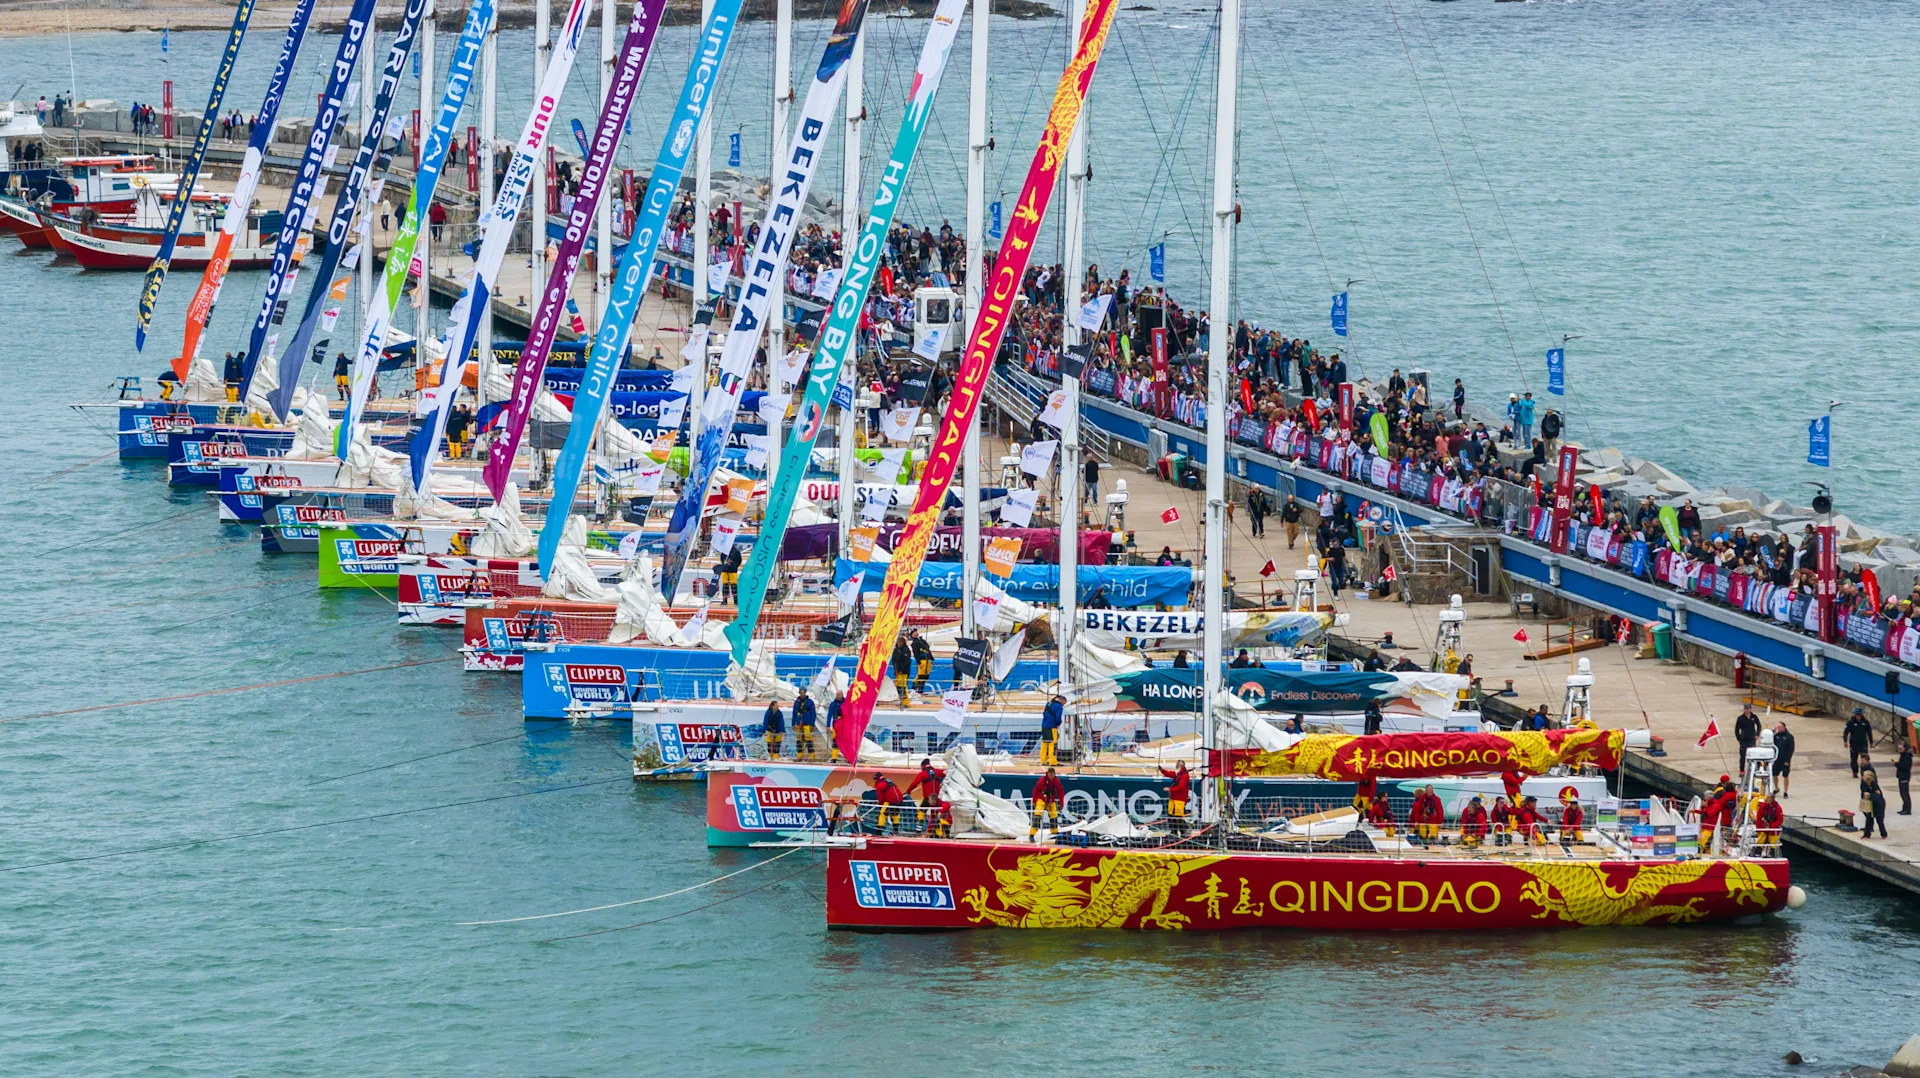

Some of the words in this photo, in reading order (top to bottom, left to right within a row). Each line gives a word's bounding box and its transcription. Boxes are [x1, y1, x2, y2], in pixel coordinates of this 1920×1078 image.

[684, 15, 729, 118] unicef
[526, 95, 555, 149] OUR
[258, 19, 365, 330] psp-logistics.com
[501, 153, 534, 222] ISLES
[873, 159, 905, 207] HA
[329, 145, 373, 246] LEAD
[566, 209, 588, 243] DC
[734, 116, 824, 332] BEKEZELA
[612, 227, 653, 320] every
[838, 215, 886, 319] LONG
[587, 324, 619, 399] child
[810, 326, 847, 396] BAY
[358, 542, 402, 554] CLIPPE
[1101, 578, 1148, 598] child
[488, 620, 505, 648] 3-24
[1086, 612, 1205, 635] BEKEZELA
[548, 665, 568, 697] 3-24
[569, 667, 622, 681] CLIPPER
[575, 692, 613, 700] WORLD
[1142, 683, 1160, 698] HA
[1163, 684, 1204, 699] LONG
[1271, 690, 1309, 700] Endless
[1311, 690, 1362, 701] Discovery
[661, 725, 681, 762] 23-24
[1384, 748, 1501, 770] QINGDAO
[739, 788, 759, 826] 23-24
[761, 790, 819, 804] CLIPPER
[765, 811, 791, 819] ROUND
[765, 817, 808, 825] WORLD
[856, 863, 879, 904] 23-24
[882, 866, 943, 882] CLIPPER
[886, 889, 914, 897] ROUND
[886, 895, 932, 904] WORLD
[1185, 872, 1264, 920] 青岛
[1269, 880, 1501, 914] QINGDAO
